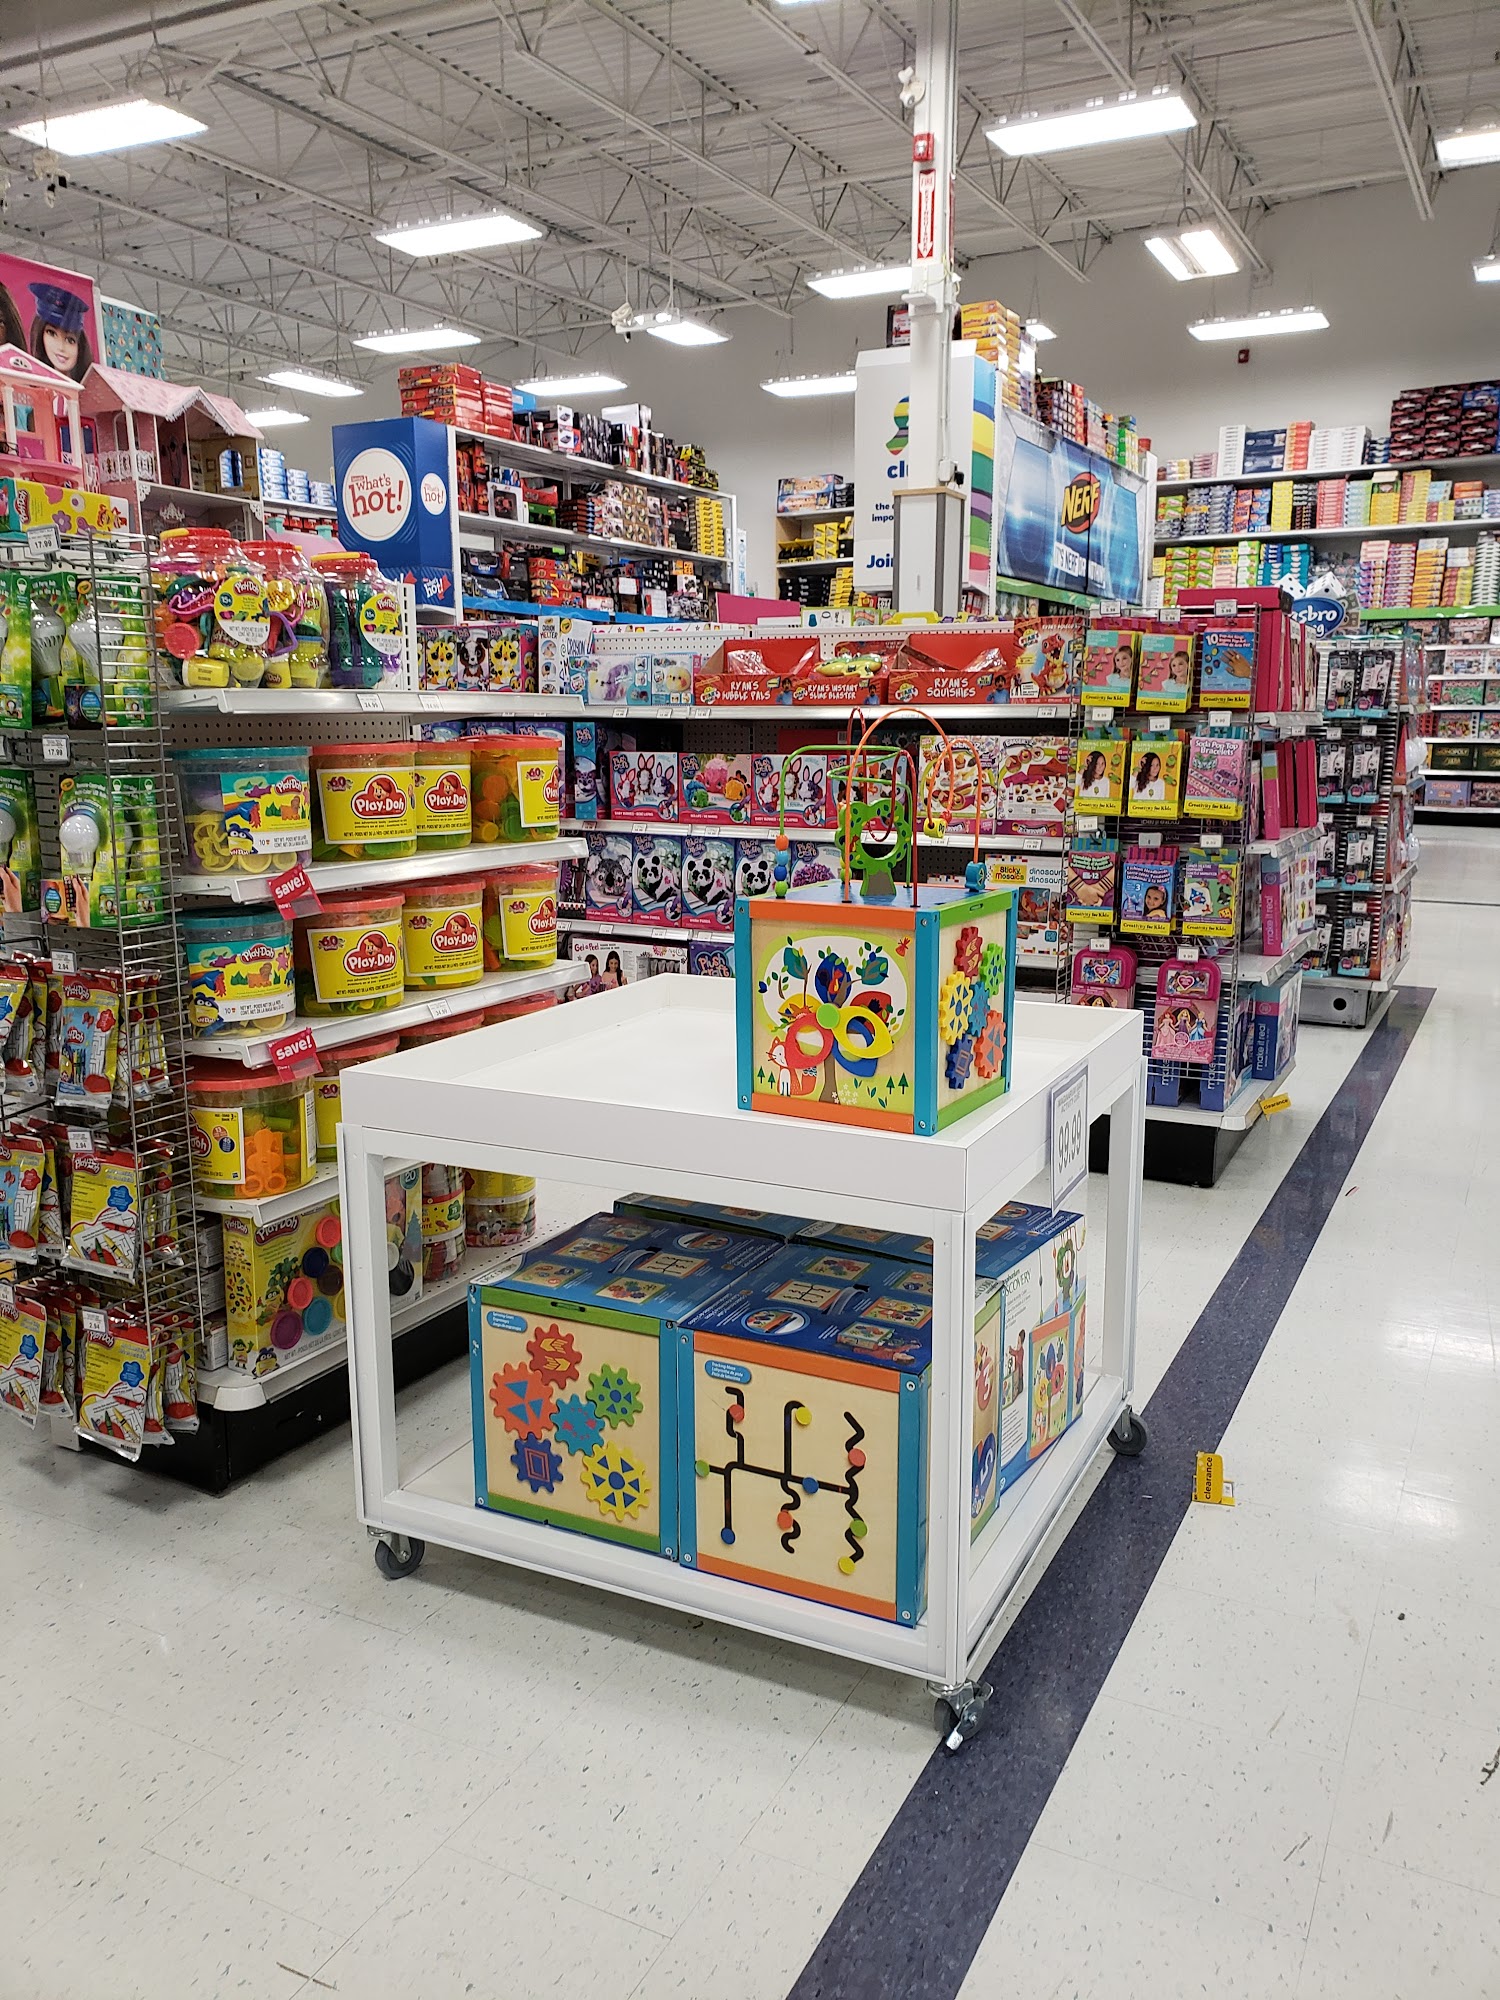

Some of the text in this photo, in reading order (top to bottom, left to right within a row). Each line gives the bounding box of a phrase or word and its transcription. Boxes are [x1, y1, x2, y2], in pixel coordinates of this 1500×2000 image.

[887, 460, 908, 479] cl
[349, 480, 404, 518] hot!
[424, 486, 445, 505] hot!
[875, 503, 890, 511] the
[1060, 479, 1100, 527] NERF
[872, 513, 894, 523] impo
[424, 578, 444, 598] hot!
[1291, 604, 1338, 625] asbro
[1451, 619, 1489, 627] MONOPOLY
[1206, 633, 1219, 646] 10
[731, 681, 759, 691] RYAN'S
[808, 684, 858, 692] RYAN'S INSTANT
[934, 677, 969, 688] RYAN'S
[1444, 680, 1480, 688] MONOPOLY
[751, 690, 771, 700] PALS
[827, 691, 857, 699] BLASTER
[926, 687, 976, 698] SQUISHIES
[1195, 740, 1239, 751] Soda Pop Top
[1200, 747, 1234, 756] Bracelets
[1437, 749, 1470, 757] MONOPOLY
[276, 778, 302, 793] Play-Doh
[330, 776, 347, 787] 60
[355, 798, 405, 813] Play-Doh
[428, 792, 467, 807] Play-Doh
[1188, 801, 1211, 809] Creativity
[995, 872, 1025, 881] Mosaics
[1000, 866, 1021, 875] Sticky
[275, 872, 306, 899] save!
[1264, 895, 1273, 913] real
[412, 915, 427, 925] 60
[1266, 919, 1274, 945] make
[321, 935, 338, 946] 60
[436, 933, 477, 947] Play-Doh
[242, 946, 275, 962] Play-Doh
[699, 953, 726, 968] Plush
[348, 953, 395, 970] Play-Doh
[1258, 1023, 1266, 1040] real
[276, 1035, 313, 1060] save!
[1256, 1046, 1265, 1071] make
[1263, 1097, 1289, 1111] clearance
[1058, 1109, 1081, 1174] 99.99
[405, 1169, 416, 1183] 20
[1004, 1269, 1032, 1297] SCOVERY
[1204, 1456, 1213, 1500] clearance
